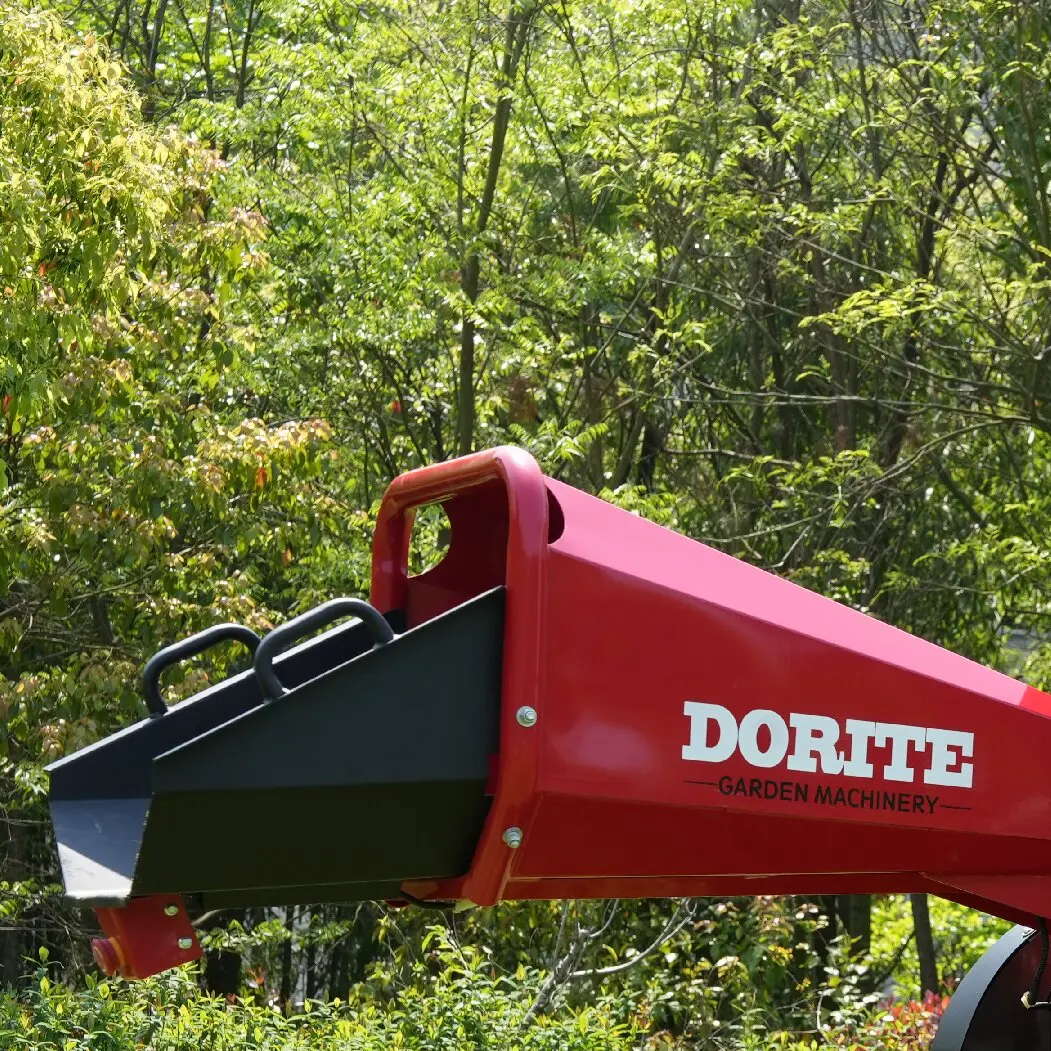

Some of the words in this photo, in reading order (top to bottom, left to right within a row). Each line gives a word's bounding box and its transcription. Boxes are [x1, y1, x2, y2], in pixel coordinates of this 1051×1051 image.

[681, 701, 974, 788] DORITE
[718, 776, 809, 804] GARDEN
[814, 786, 939, 814] MACHINERY
